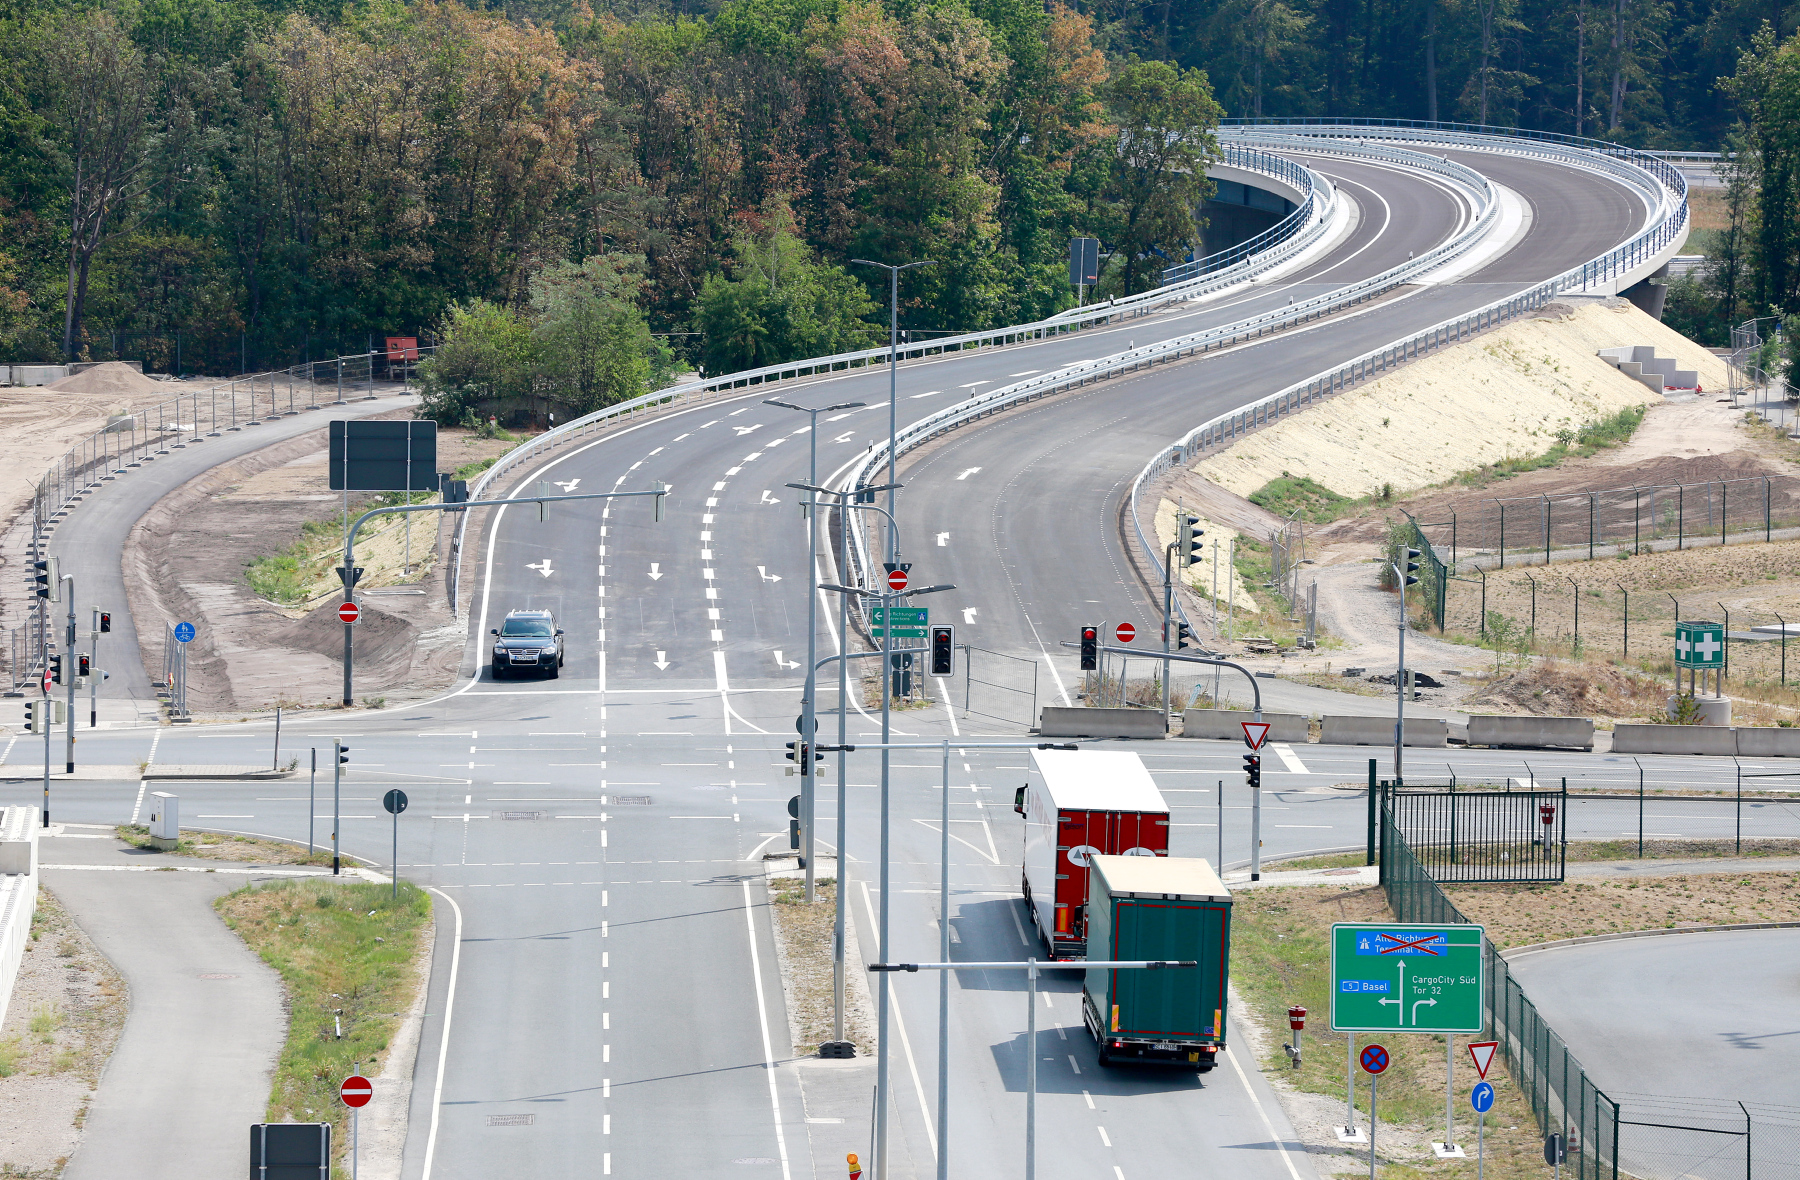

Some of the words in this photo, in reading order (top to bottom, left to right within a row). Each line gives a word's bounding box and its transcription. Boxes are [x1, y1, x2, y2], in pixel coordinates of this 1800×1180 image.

[1412, 976, 1455, 985] CargoCity
[1459, 976, 1476, 984] Süd
[1362, 982, 1387, 991] Basel
[1412, 986, 1427, 994] Tor
[1431, 986, 1442, 994] 32
